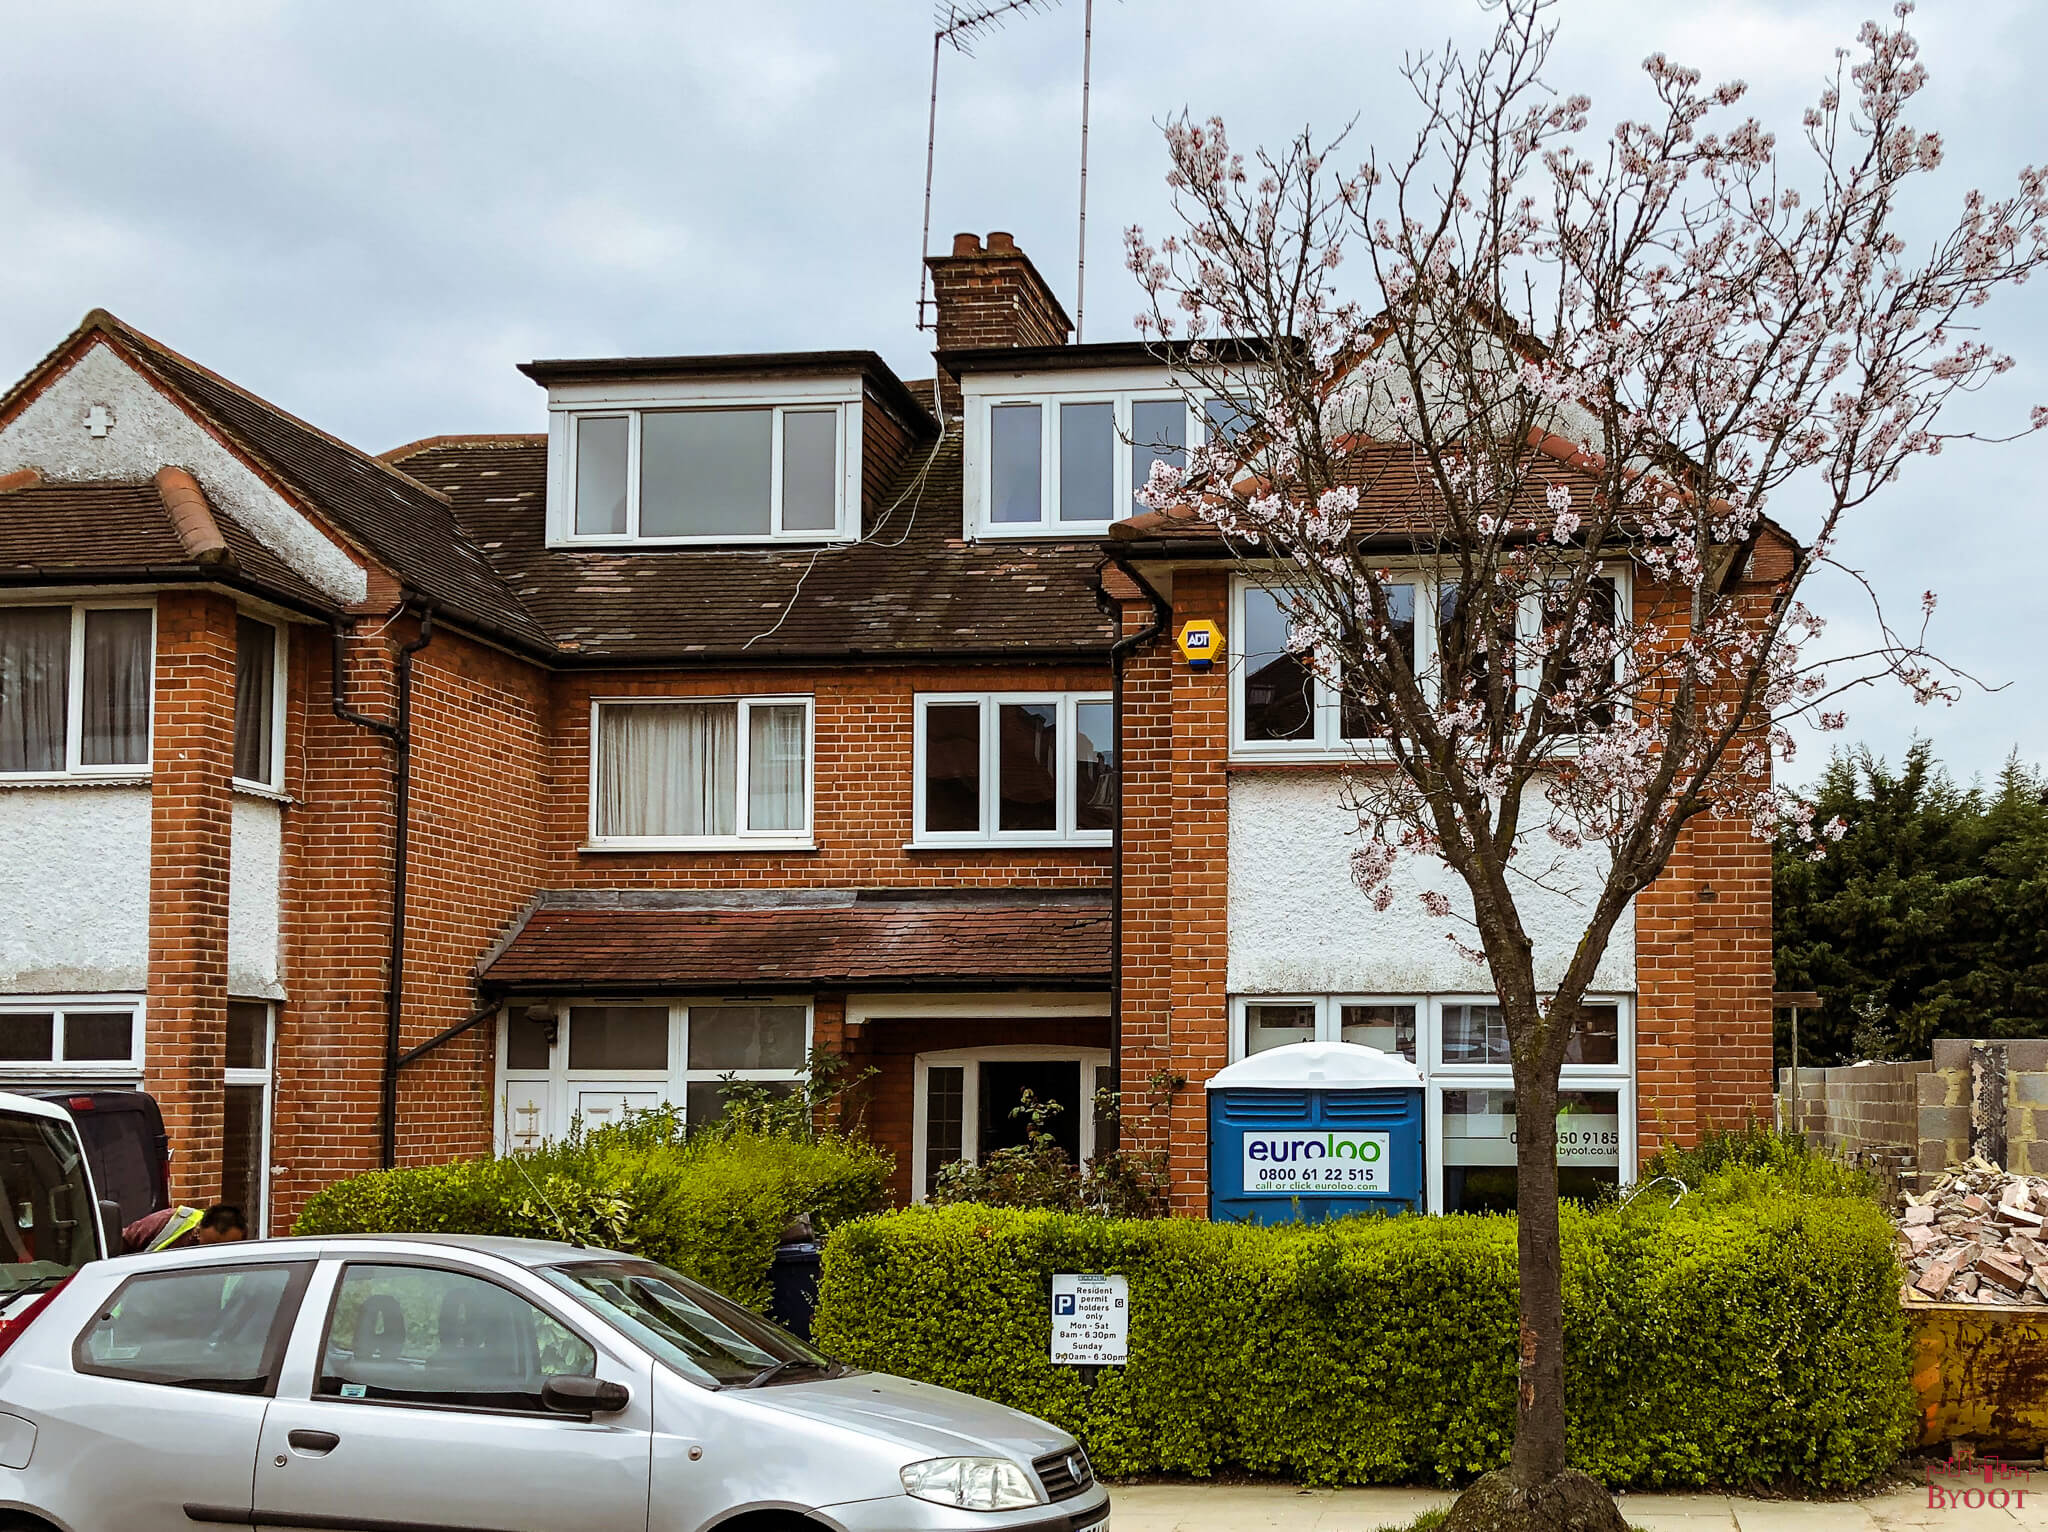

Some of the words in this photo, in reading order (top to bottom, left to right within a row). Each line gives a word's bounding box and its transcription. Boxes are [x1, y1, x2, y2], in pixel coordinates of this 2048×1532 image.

[1187, 632, 1209, 646] ADT
[1557, 1132, 1578, 1144] 50
[1582, 1132, 1618, 1144] 9185
[1249, 1134, 1381, 1162] euroloo
[1259, 1168, 1296, 1180] 0800
[1302, 1168, 1317, 1180] 61
[1324, 1168, 1342, 1180] 22
[1348, 1168, 1374, 1180] 515
[1255, 1181, 1272, 1190] call
[1275, 1182, 1286, 1190] or
[1289, 1181, 1312, 1190] click
[1315, 1182, 1378, 1191] euroloo.com
[1058, 1296, 1072, 1314] P
[1081, 1295, 1108, 1303] permit
[1072, 1342, 1103, 1351] Sunday
